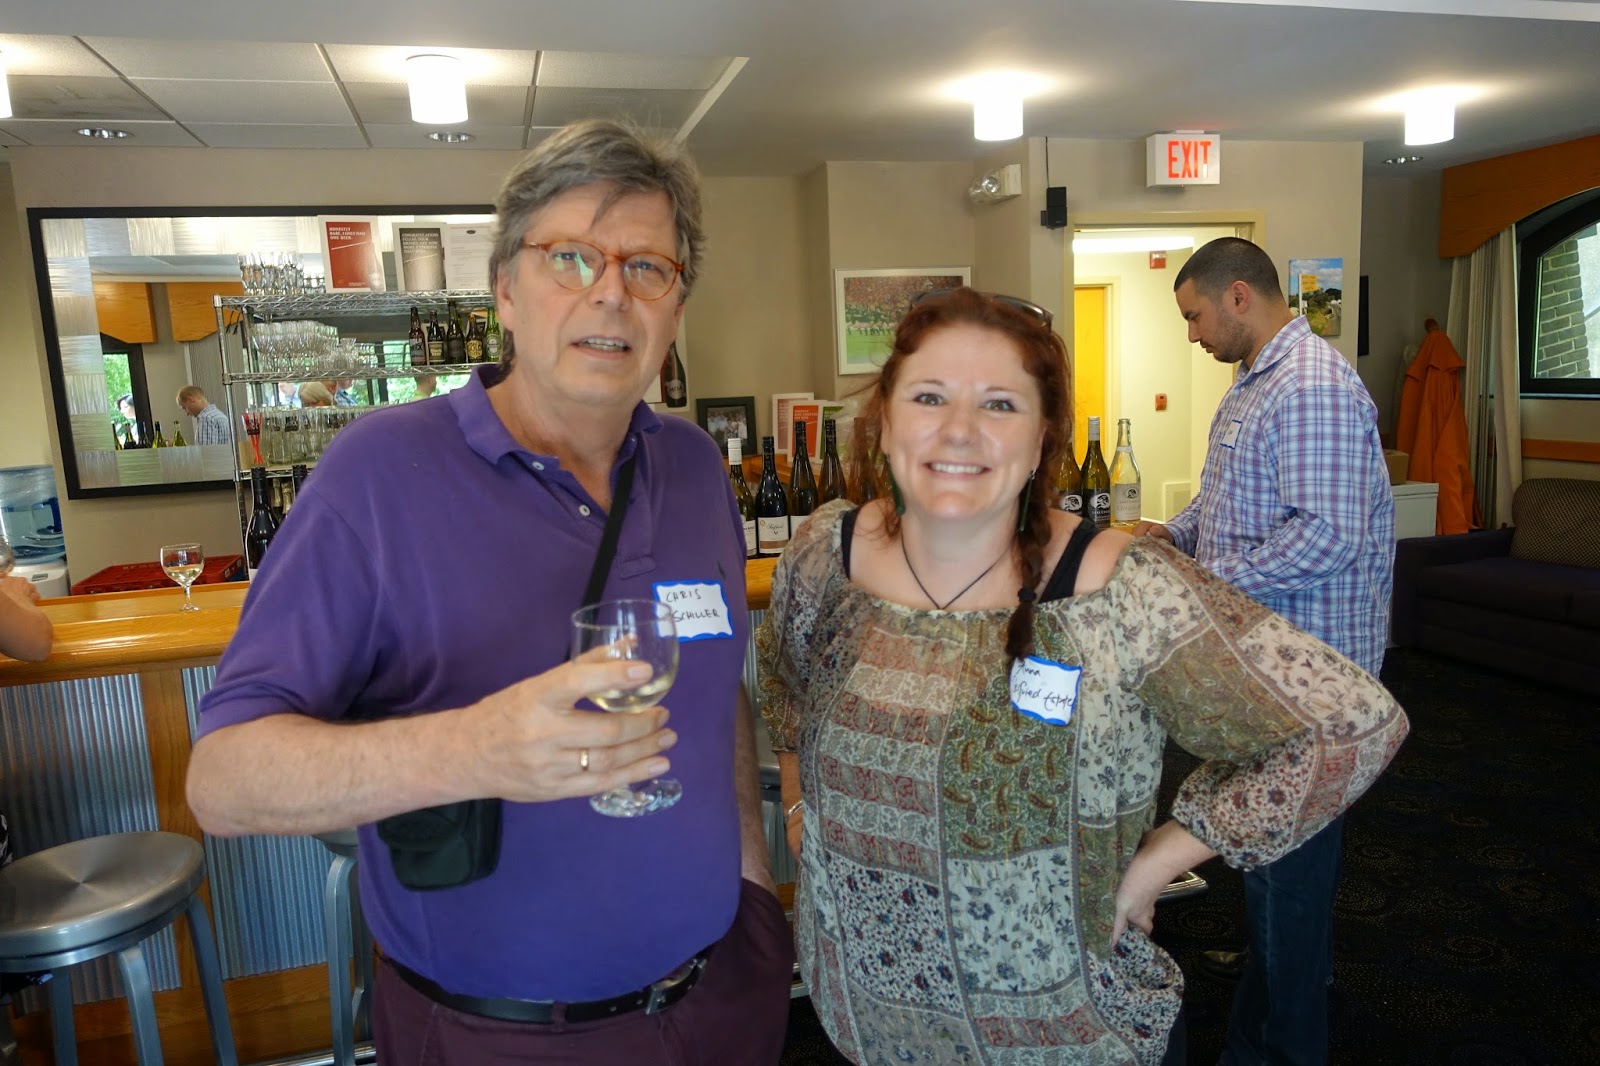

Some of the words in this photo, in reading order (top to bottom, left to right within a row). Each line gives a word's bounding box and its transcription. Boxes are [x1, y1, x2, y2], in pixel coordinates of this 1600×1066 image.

[1168, 140, 1212, 179] EXIT
[666, 588, 702, 603] CHRIS
[672, 608, 720, 622] SCHILLER
